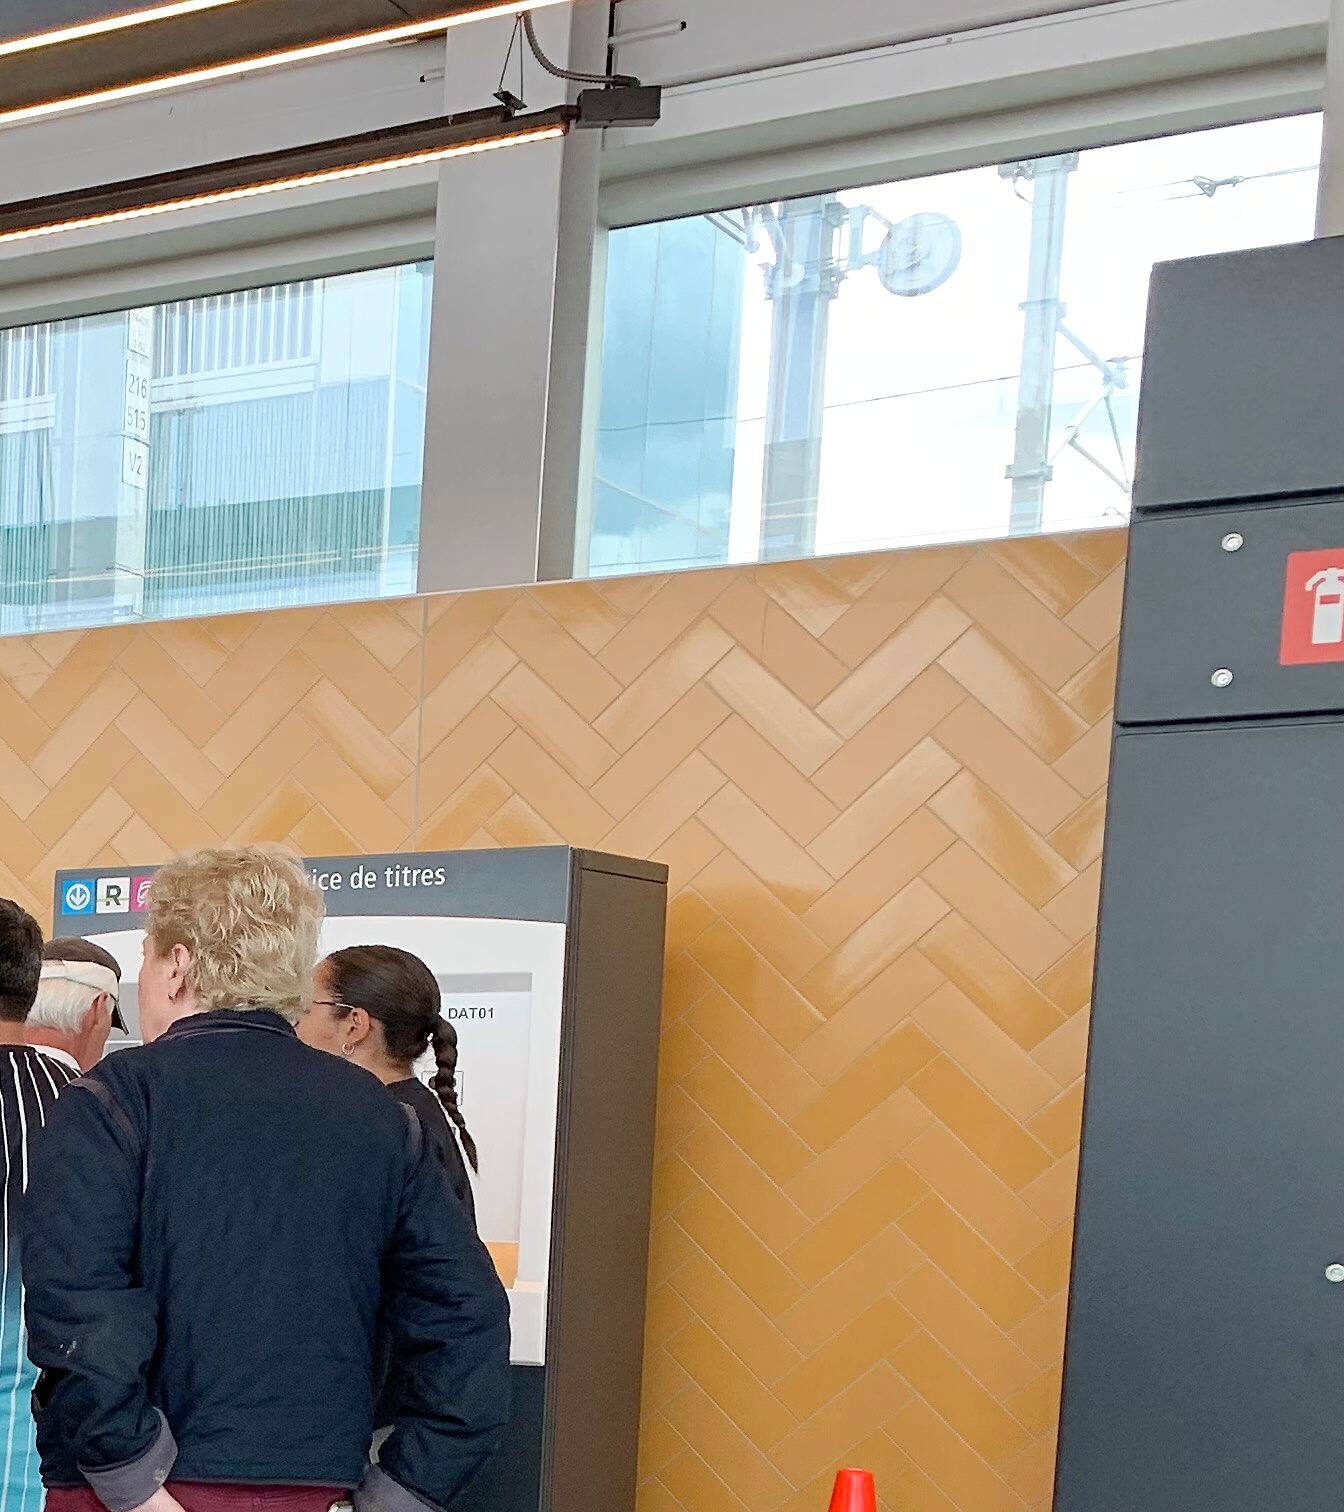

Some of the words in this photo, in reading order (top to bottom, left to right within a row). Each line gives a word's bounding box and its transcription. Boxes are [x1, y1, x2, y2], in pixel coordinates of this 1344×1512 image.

[128, 373, 148, 399] 216
[127, 405, 146, 431] 515
[128, 450, 144, 476] V2
[105, 885, 122, 906] R
[350, 865, 377, 889] de
[384, 864, 446, 888] titres
[448, 1007, 494, 1020] DAT01
